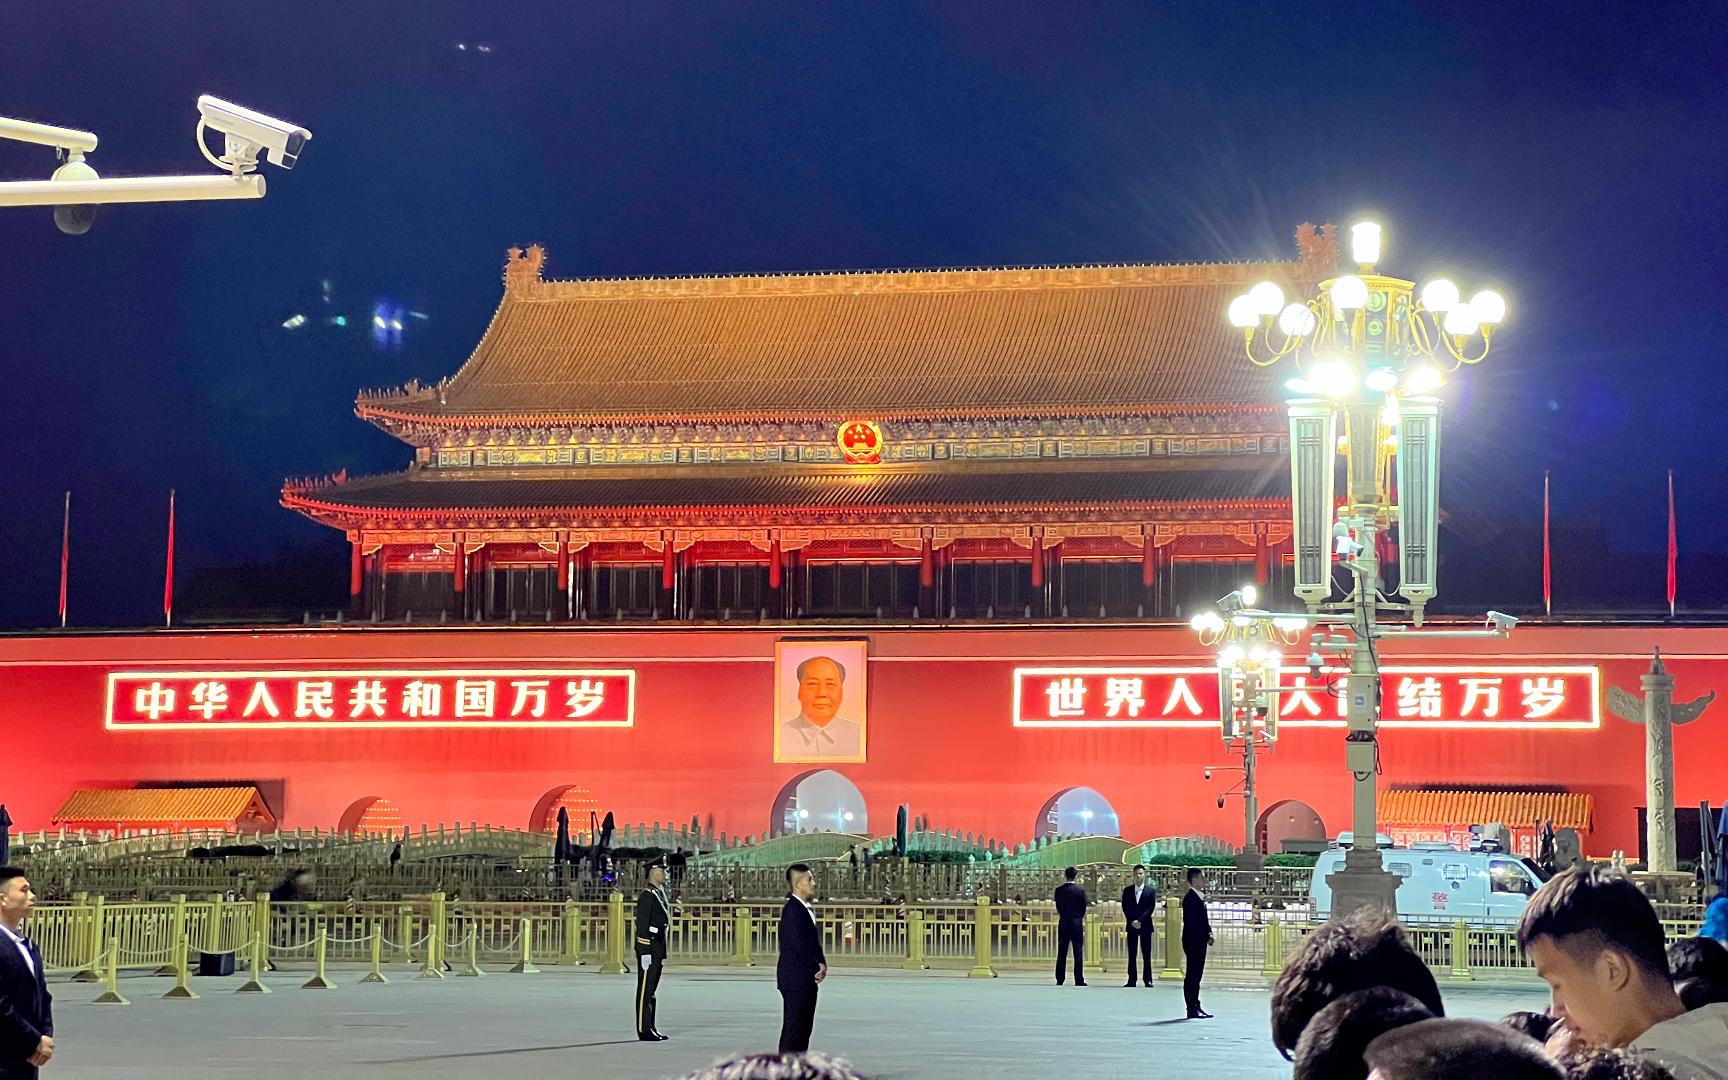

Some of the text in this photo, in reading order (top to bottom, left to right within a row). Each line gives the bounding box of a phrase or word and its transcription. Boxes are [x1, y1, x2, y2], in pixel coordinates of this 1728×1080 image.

[134, 679, 606, 720] 中华人民共和国万岁
[1044, 676, 1567, 719] 世界人大结万岁
